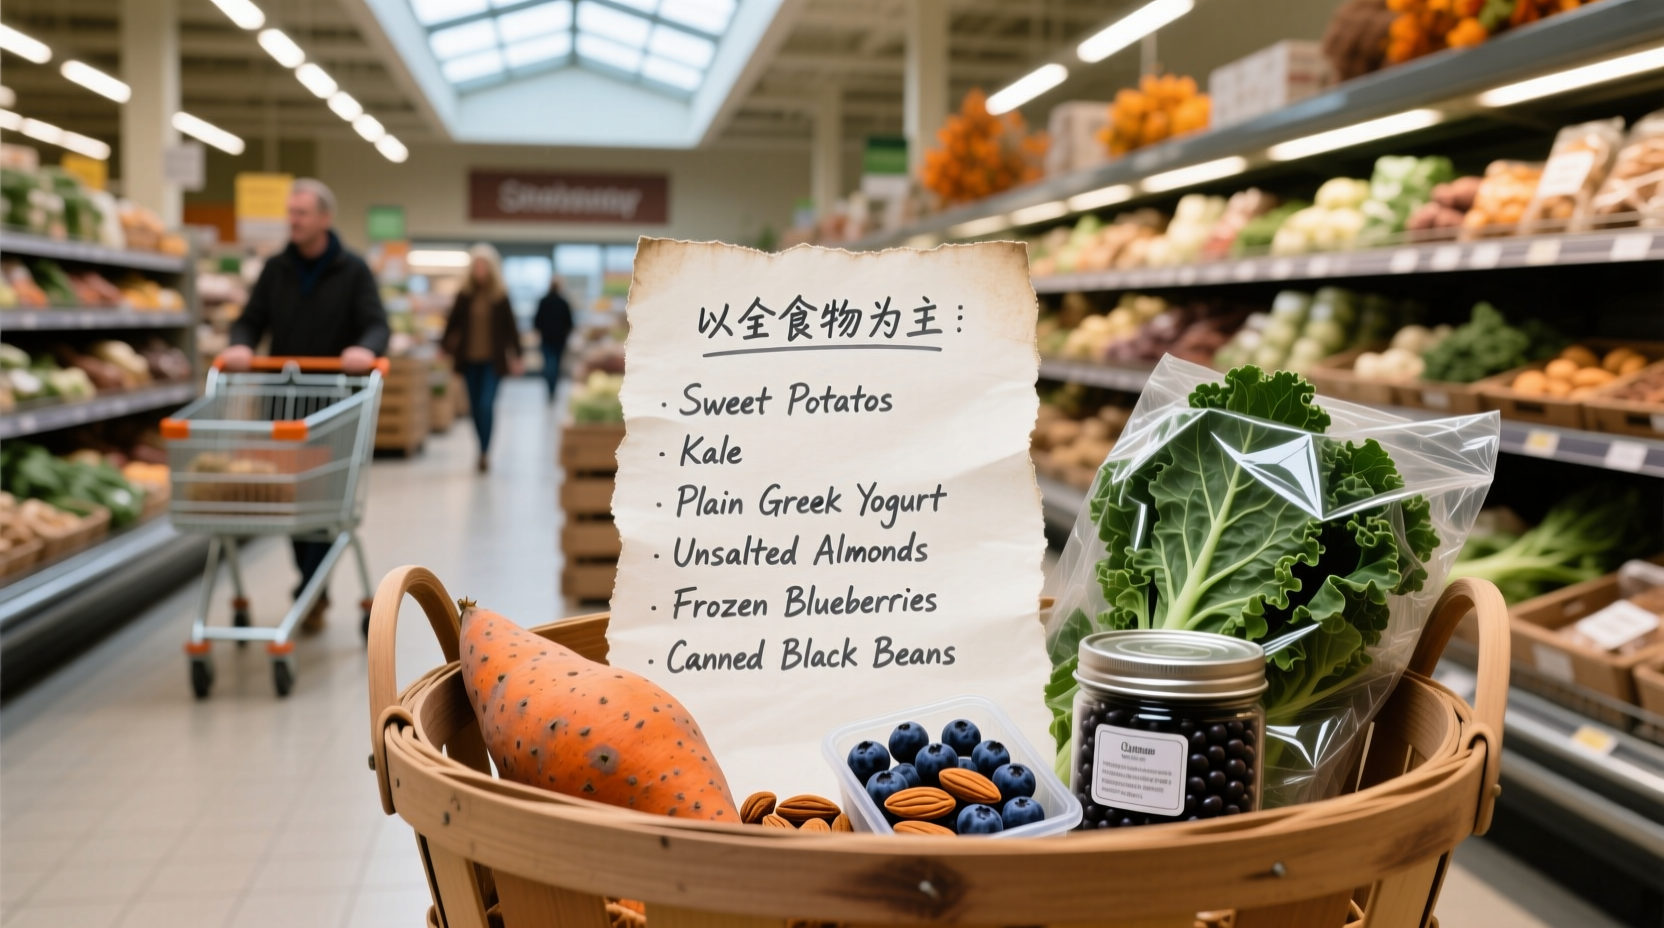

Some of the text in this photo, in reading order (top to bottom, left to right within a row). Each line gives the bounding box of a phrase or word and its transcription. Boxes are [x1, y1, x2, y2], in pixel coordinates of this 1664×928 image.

[679, 382, 893, 416] Sweet Potatos
[679, 433, 743, 467] Kale
[676, 481, 948, 530] Plain Greek Yogurt
[673, 530, 928, 568] Unsalted Almonds
[673, 584, 937, 620] Frozen Blueberries
[666, 635, 956, 674] Canned Black Beans
